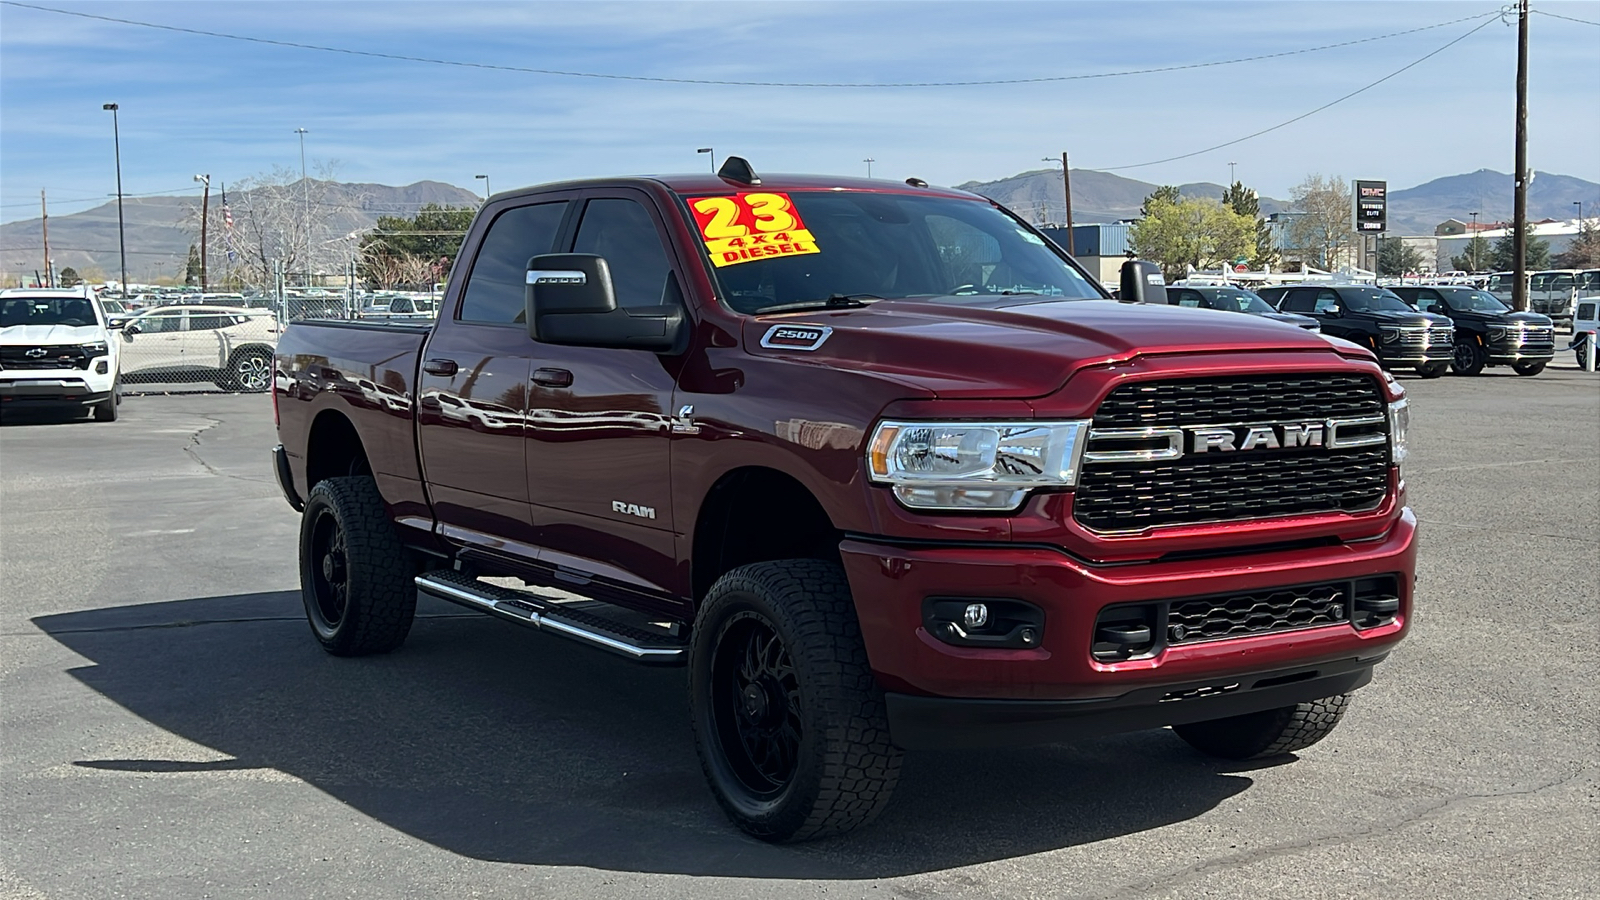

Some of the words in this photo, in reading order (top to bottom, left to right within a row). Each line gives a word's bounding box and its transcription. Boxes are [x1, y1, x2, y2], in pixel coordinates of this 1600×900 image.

[1361, 188, 1385, 196] GMC
[694, 193, 798, 239] 23
[722, 242, 810, 263] DIESEL
[776, 330, 819, 340] 2500
[1193, 422, 1323, 453] RAM
[612, 500, 656, 519] RAM
